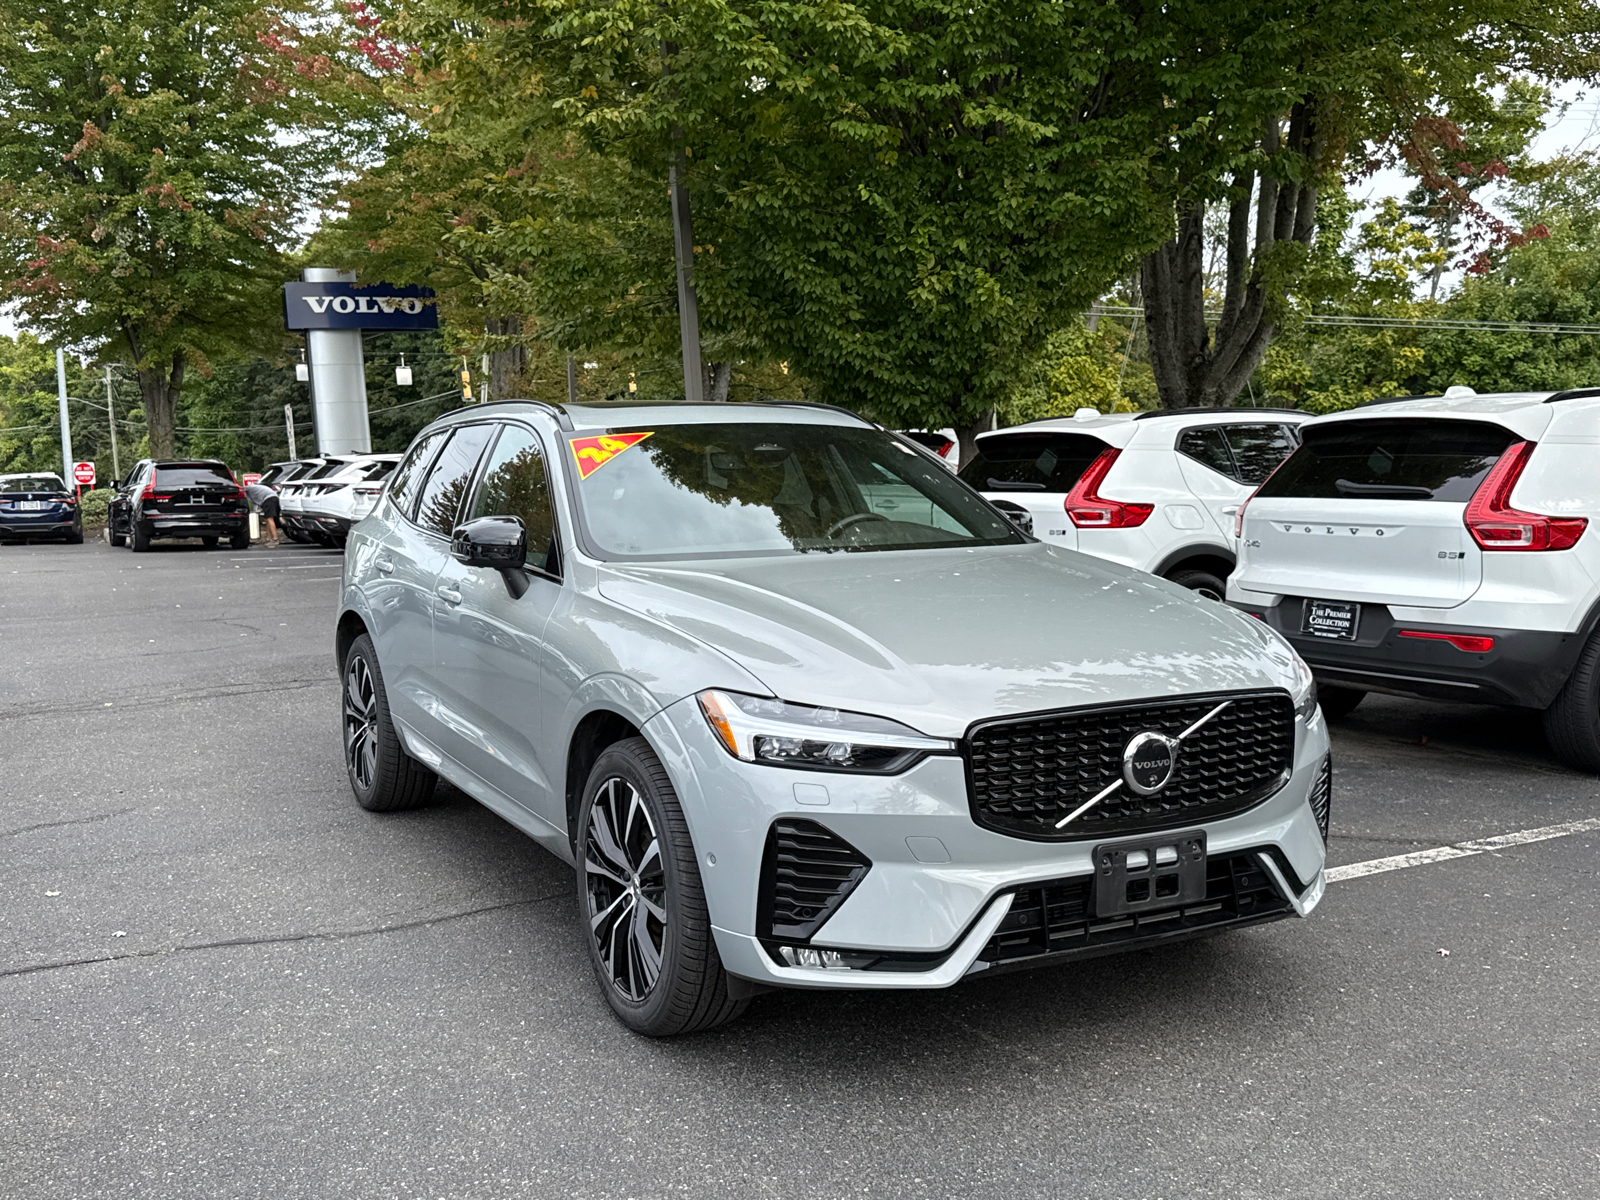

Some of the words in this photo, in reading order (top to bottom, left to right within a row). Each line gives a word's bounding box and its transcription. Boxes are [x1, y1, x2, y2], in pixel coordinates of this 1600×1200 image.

[302, 296, 423, 315] VOLVO
[578, 437, 628, 463] 24
[1284, 525, 1385, 536] VOLVO
[1134, 759, 1170, 770] VOLVO
